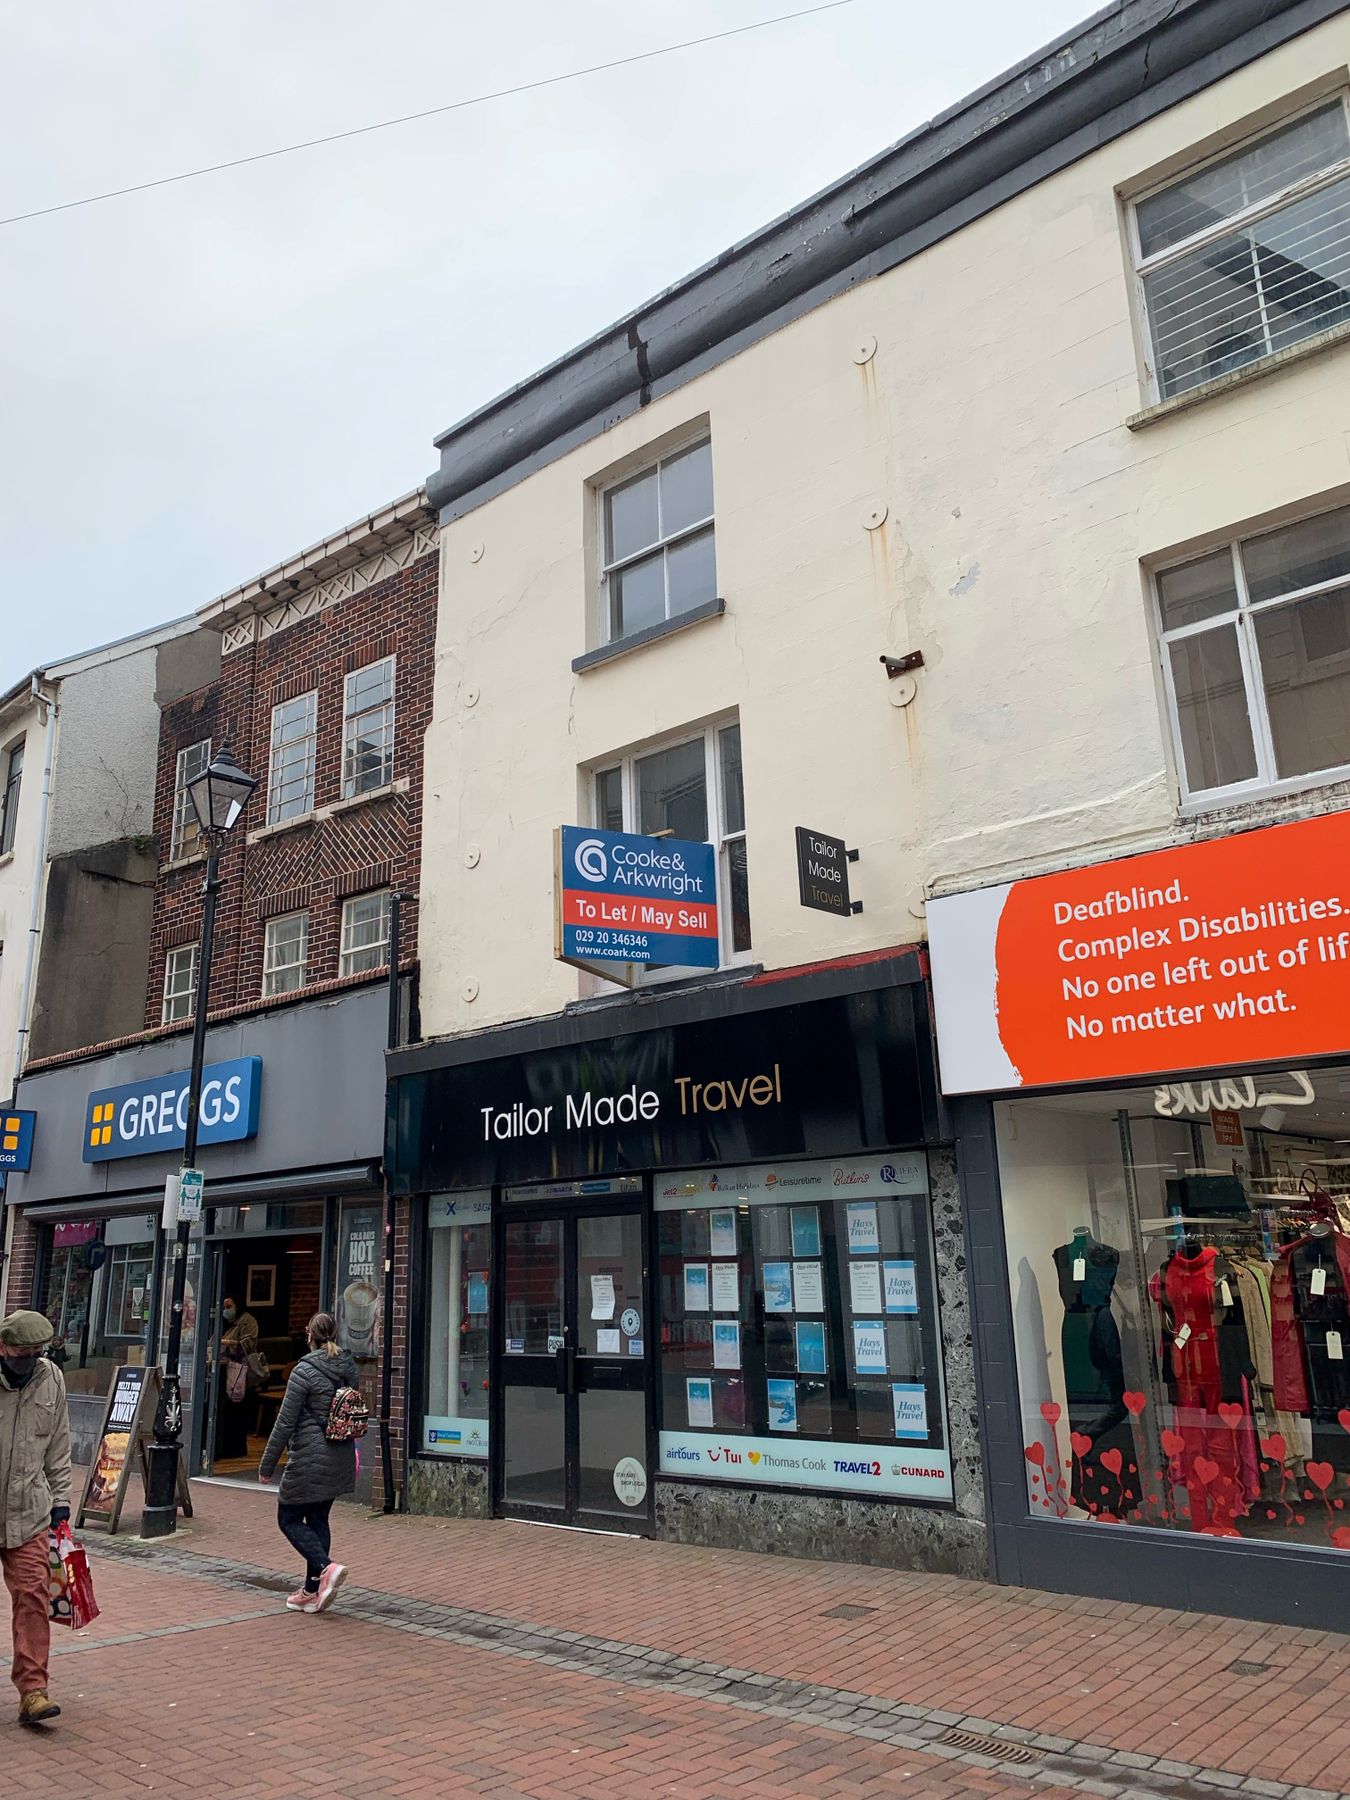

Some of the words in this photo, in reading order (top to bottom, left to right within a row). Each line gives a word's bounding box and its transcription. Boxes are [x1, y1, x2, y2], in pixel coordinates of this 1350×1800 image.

[808, 836, 837, 859] Tailor
[611, 845, 685, 872] Cooke&
[808, 861, 841, 883] Made
[612, 868, 703, 895] Arkwright
[811, 885, 843, 907] Travel
[1053, 878, 1190, 925] Deafblind.
[575, 899, 596, 918] To
[601, 903, 627, 922] Let
[631, 905, 636, 923] /
[641, 907, 672, 929] May
[678, 909, 707, 929] Sell
[1058, 924, 1172, 962] Complex
[1178, 896, 1350, 943] Disabilities.
[575, 930, 594, 943] 029
[597, 931, 609, 944] 20
[611, 933, 648, 947] 346346
[576, 946, 650, 959] www.coark.com
[1062, 976, 1099, 1001] No
[1106, 970, 1156, 994] one
[1162, 956, 1212, 987] left
[1219, 948, 1270, 978] out
[1278, 939, 1308, 968] of
[1318, 931, 1350, 962] lif
[1067, 1015, 1104, 1040] No
[1111, 1002, 1205, 1034] matter
[1211, 989, 1297, 1020] what.
[481, 1103, 553, 1141] Tailor
[566, 1085, 660, 1130] Made
[674, 1063, 782, 1115] Travel
[779, 1176, 822, 1186] Leisuretime
[850, 1228, 875, 1236] Travel
[853, 1219, 873, 1229] Hays
[349, 1240, 375, 1263] HOT
[349, 1263, 374, 1276] COFFEE
[887, 1287, 914, 1296] Travel
[890, 1278, 911, 1288] Hays
[859, 1338, 880, 1347] Hays
[857, 1347, 882, 1356] Travel
[110, 1403, 136, 1422] AWAY
[900, 1401, 921, 1411] Hays
[896, 1410, 923, 1420] Travel
[666, 1446, 700, 1461] airtours
[763, 1454, 800, 1469] Thomas
[802, 1458, 827, 1471] Cook
[834, 1461, 881, 1476] TRAVEL2
[901, 1467, 945, 1478] CUNARD
